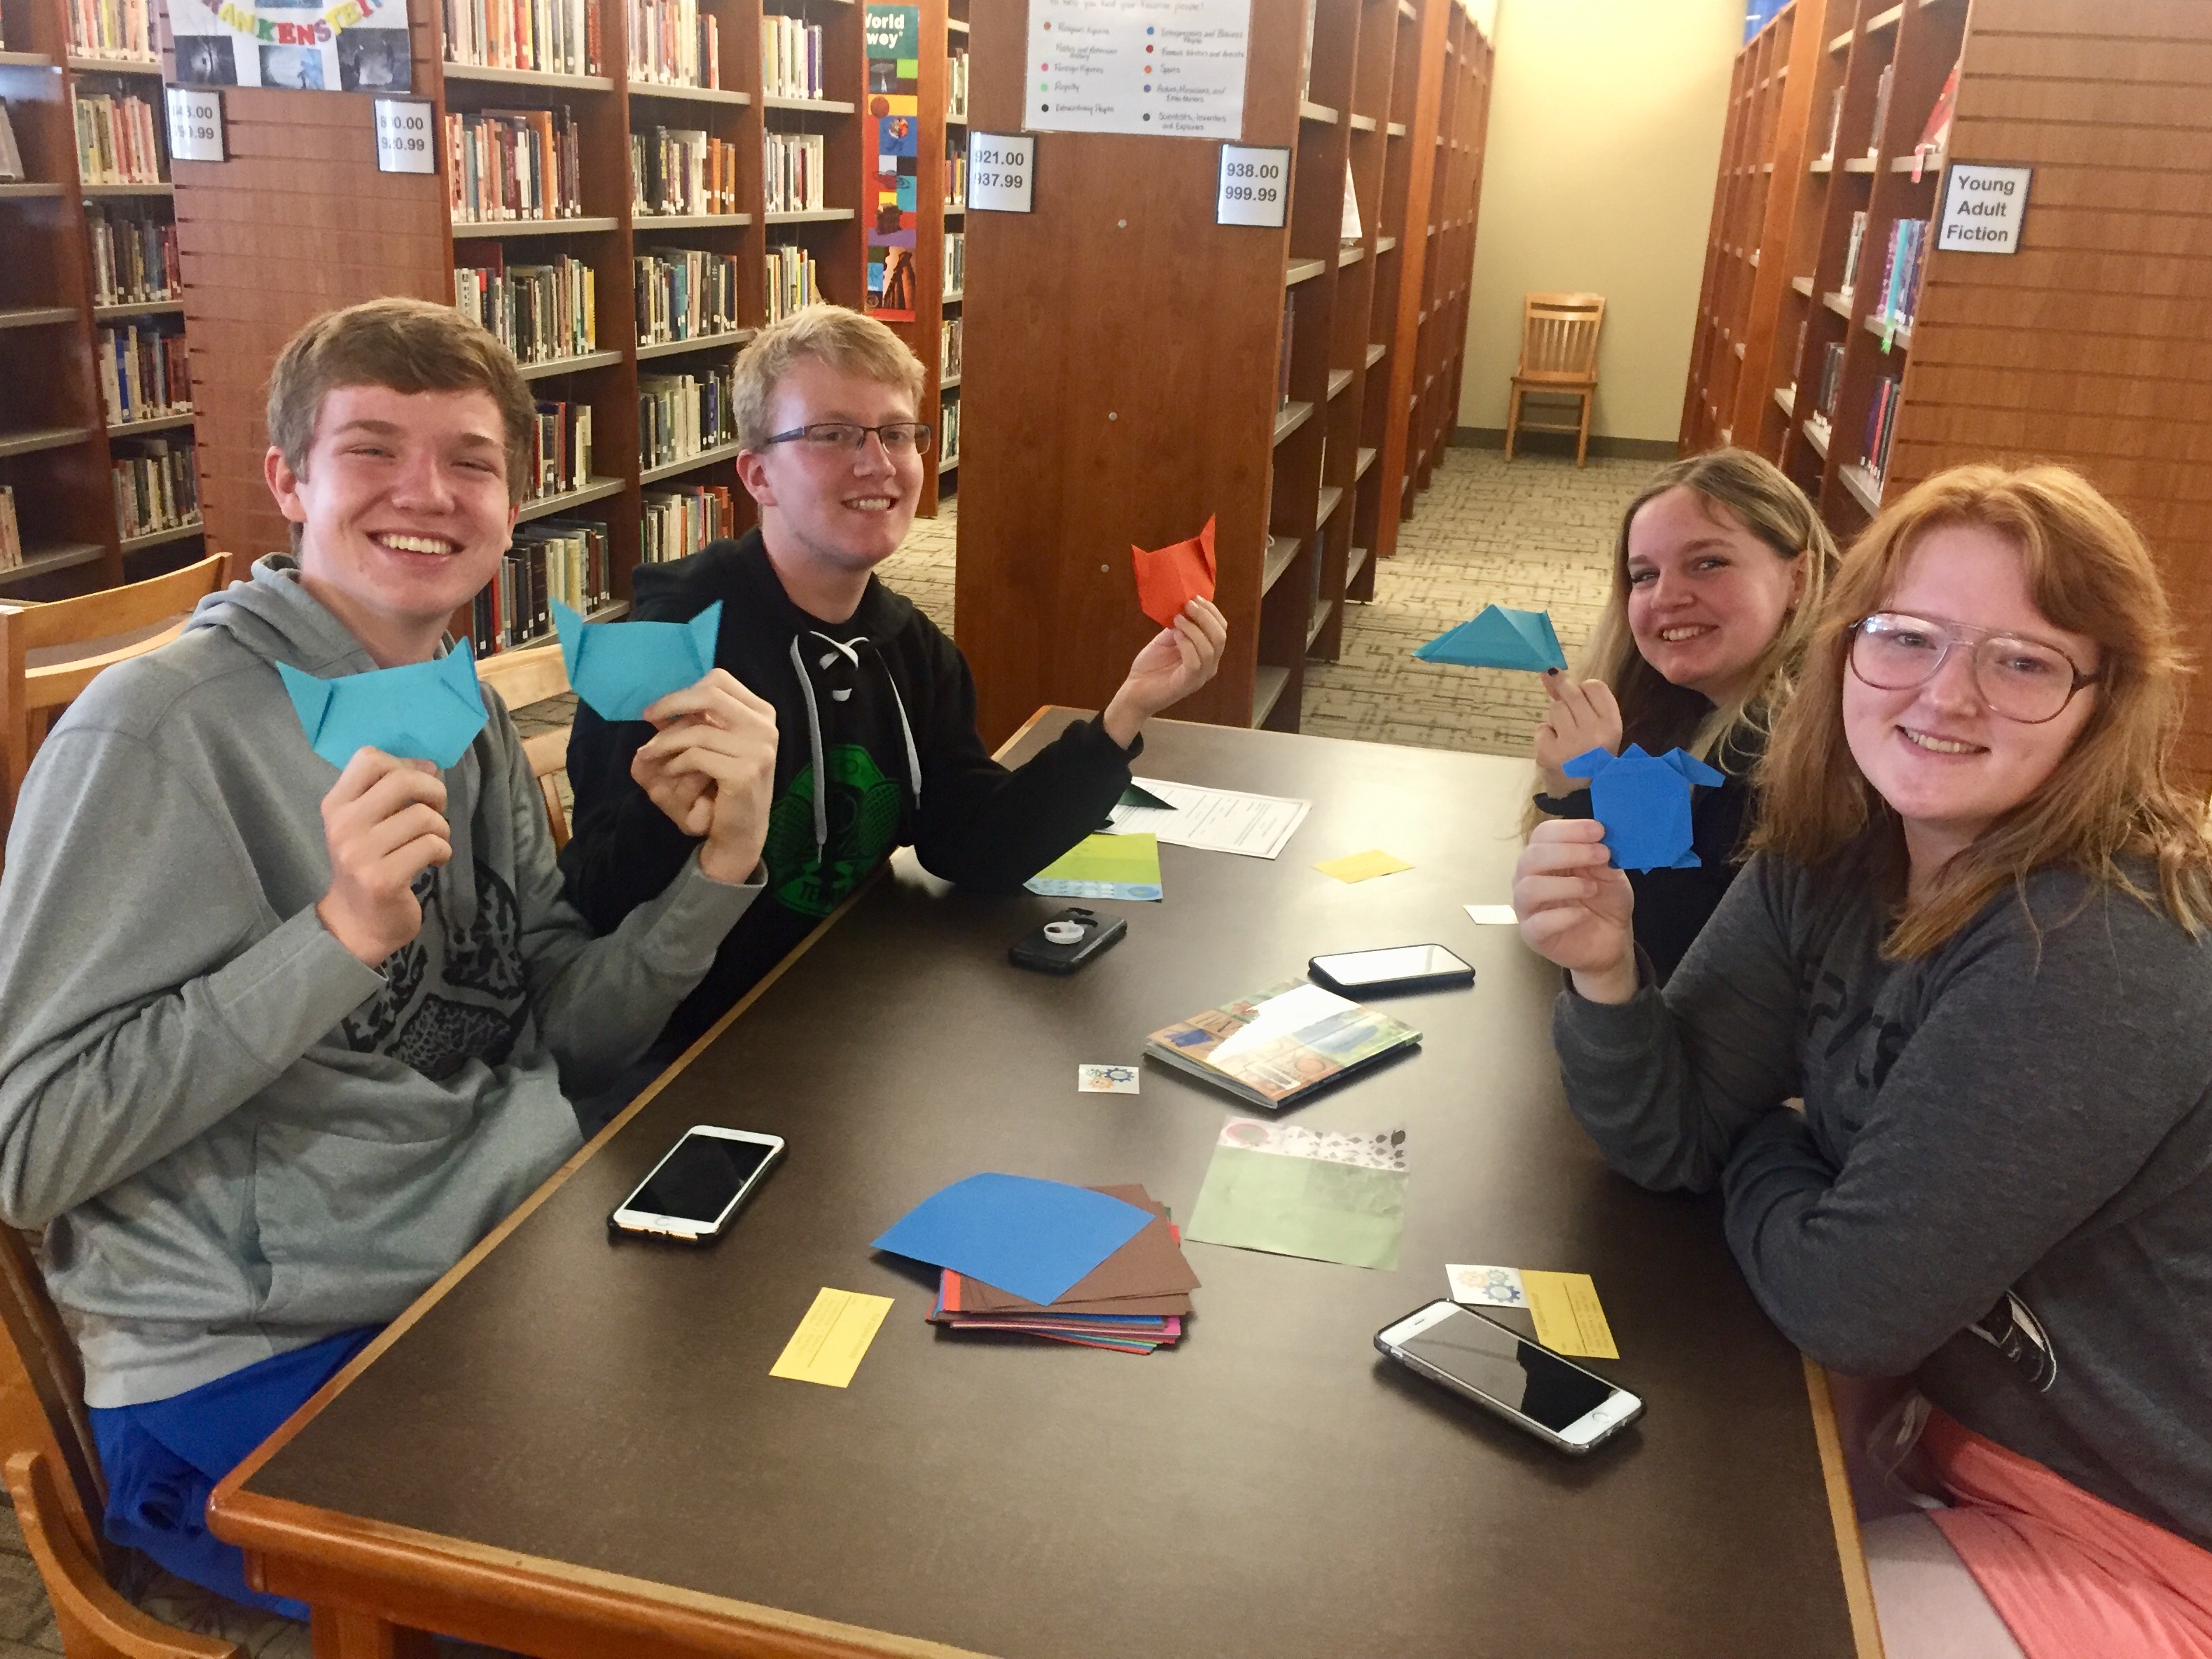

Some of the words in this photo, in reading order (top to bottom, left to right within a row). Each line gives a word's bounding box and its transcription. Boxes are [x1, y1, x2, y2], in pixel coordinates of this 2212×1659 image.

[202, 0, 384, 45] ANKENSTEI
[380, 116, 424, 130] 80.00
[975, 150, 1024, 166] 921.00
[1227, 162, 1279, 179] 938.00
[974, 172, 1024, 188] 937.99
[1959, 175, 2015, 196] Young
[1225, 186, 1277, 202] 999.99
[1957, 200, 2007, 217] Adult
[1947, 224, 2008, 242] Fiction
